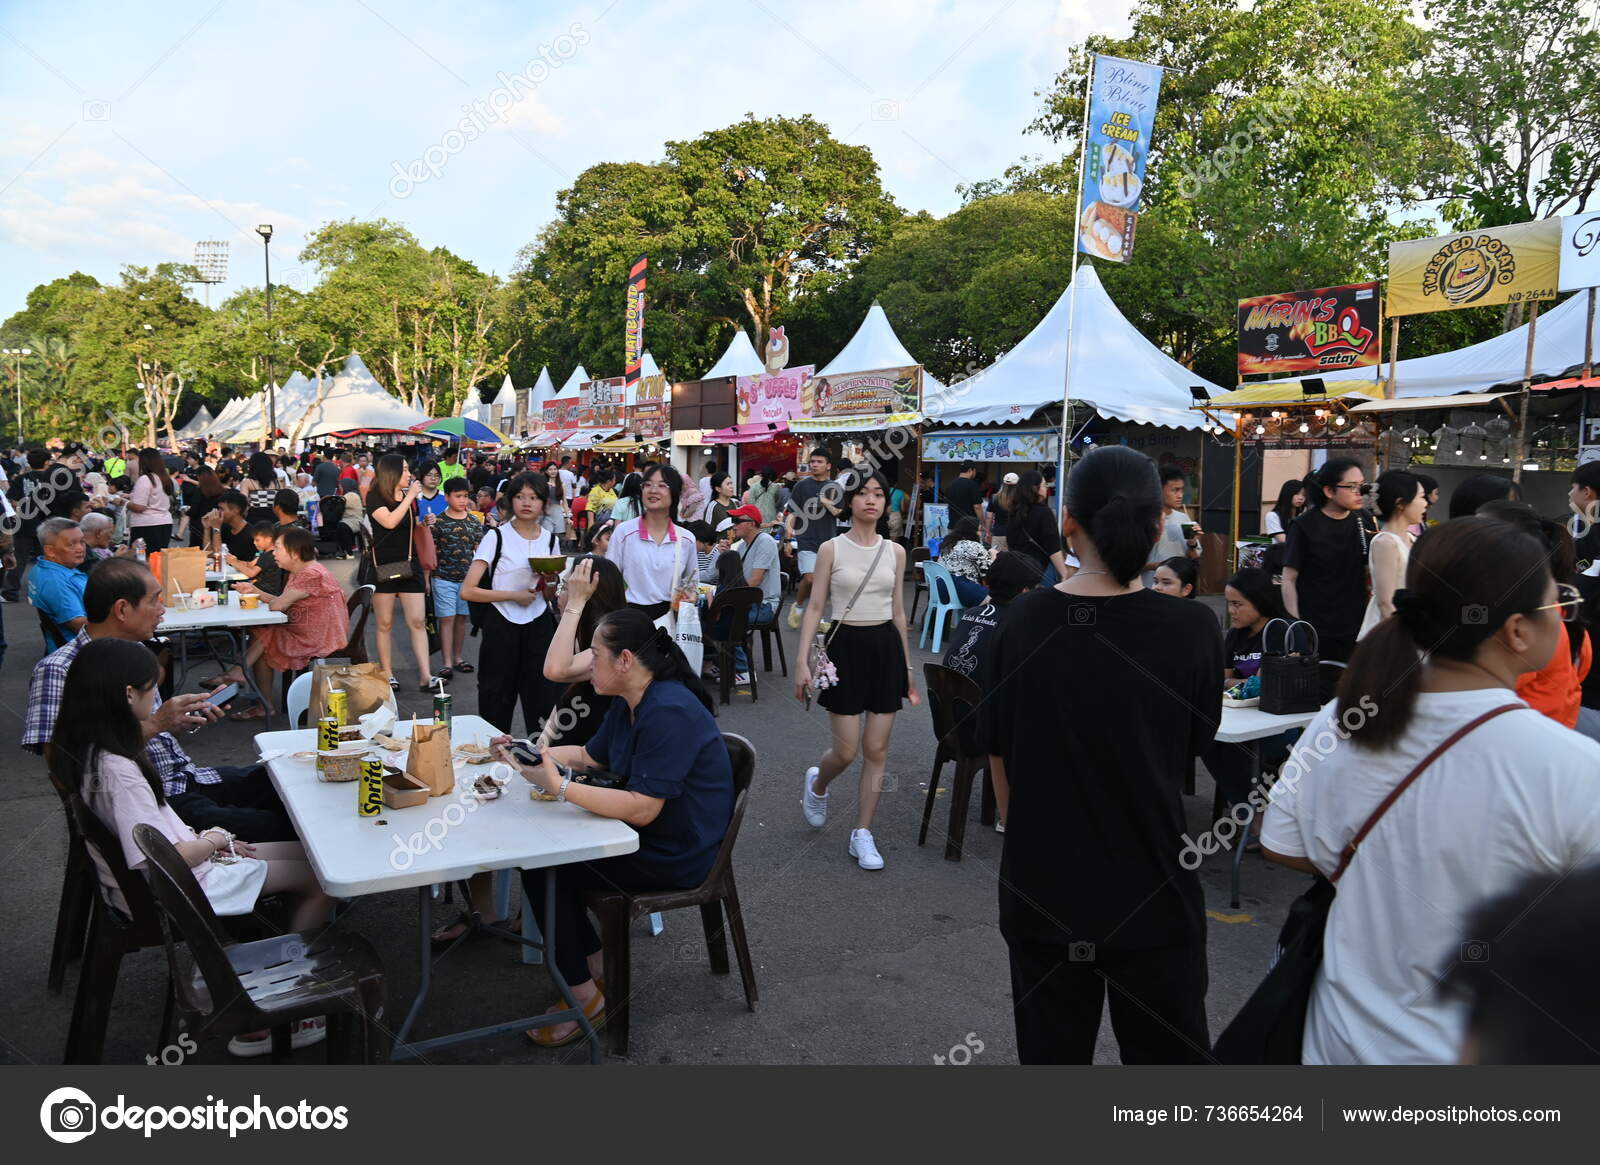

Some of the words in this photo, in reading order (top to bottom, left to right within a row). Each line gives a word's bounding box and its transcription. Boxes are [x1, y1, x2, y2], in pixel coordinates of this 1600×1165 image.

[1104, 67, 1151, 95] Bling
[1102, 85, 1148, 112] Bling
[1101, 123, 1139, 143] CREAM
[1111, 111, 1132, 127] ICE
[1423, 236, 1474, 297] TWISTED
[1476, 235, 1517, 285] POTATO
[1243, 297, 1338, 332] MARIN'S
[1315, 306, 1366, 347] BBQ
[1319, 352, 1359, 366] satay
[363, 761, 383, 815] Sprite
